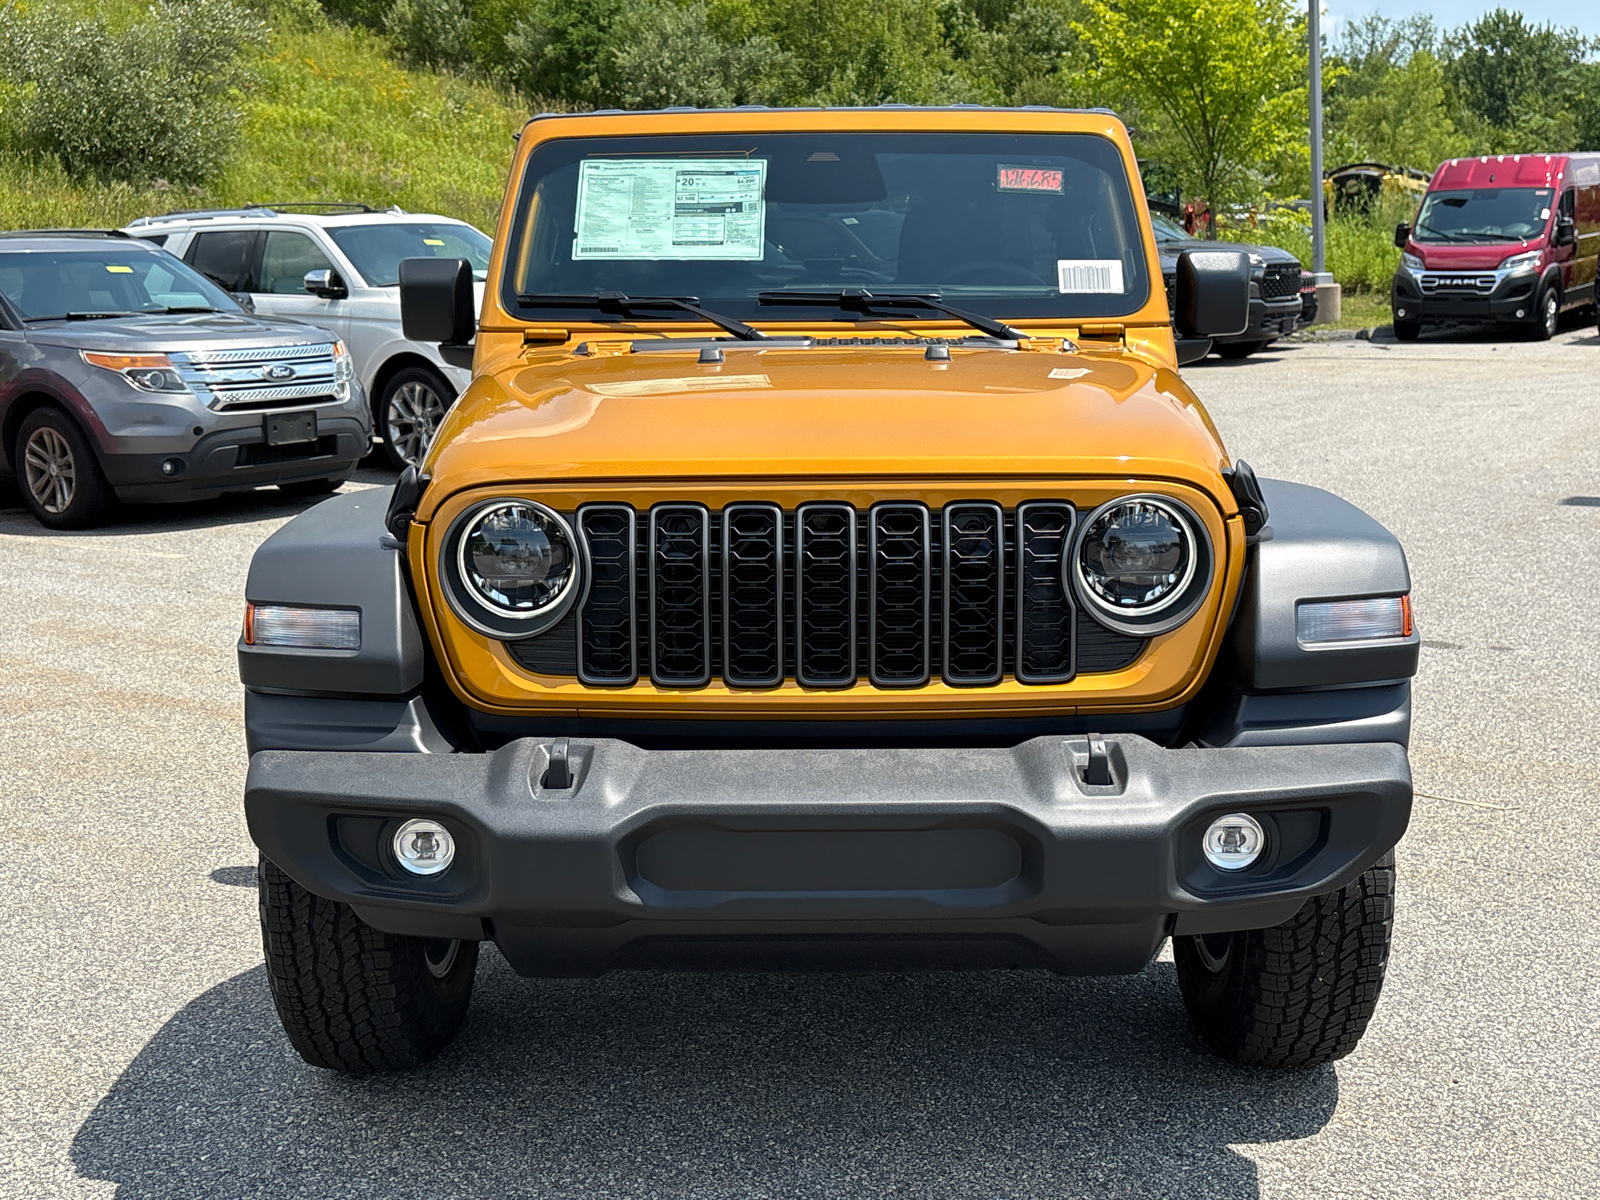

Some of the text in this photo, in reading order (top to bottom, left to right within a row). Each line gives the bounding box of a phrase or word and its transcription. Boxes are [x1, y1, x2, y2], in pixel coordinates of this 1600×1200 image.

[681, 177, 695, 186] 20
[1439, 278, 1476, 286] RAM
[272, 367, 290, 377] Ford
